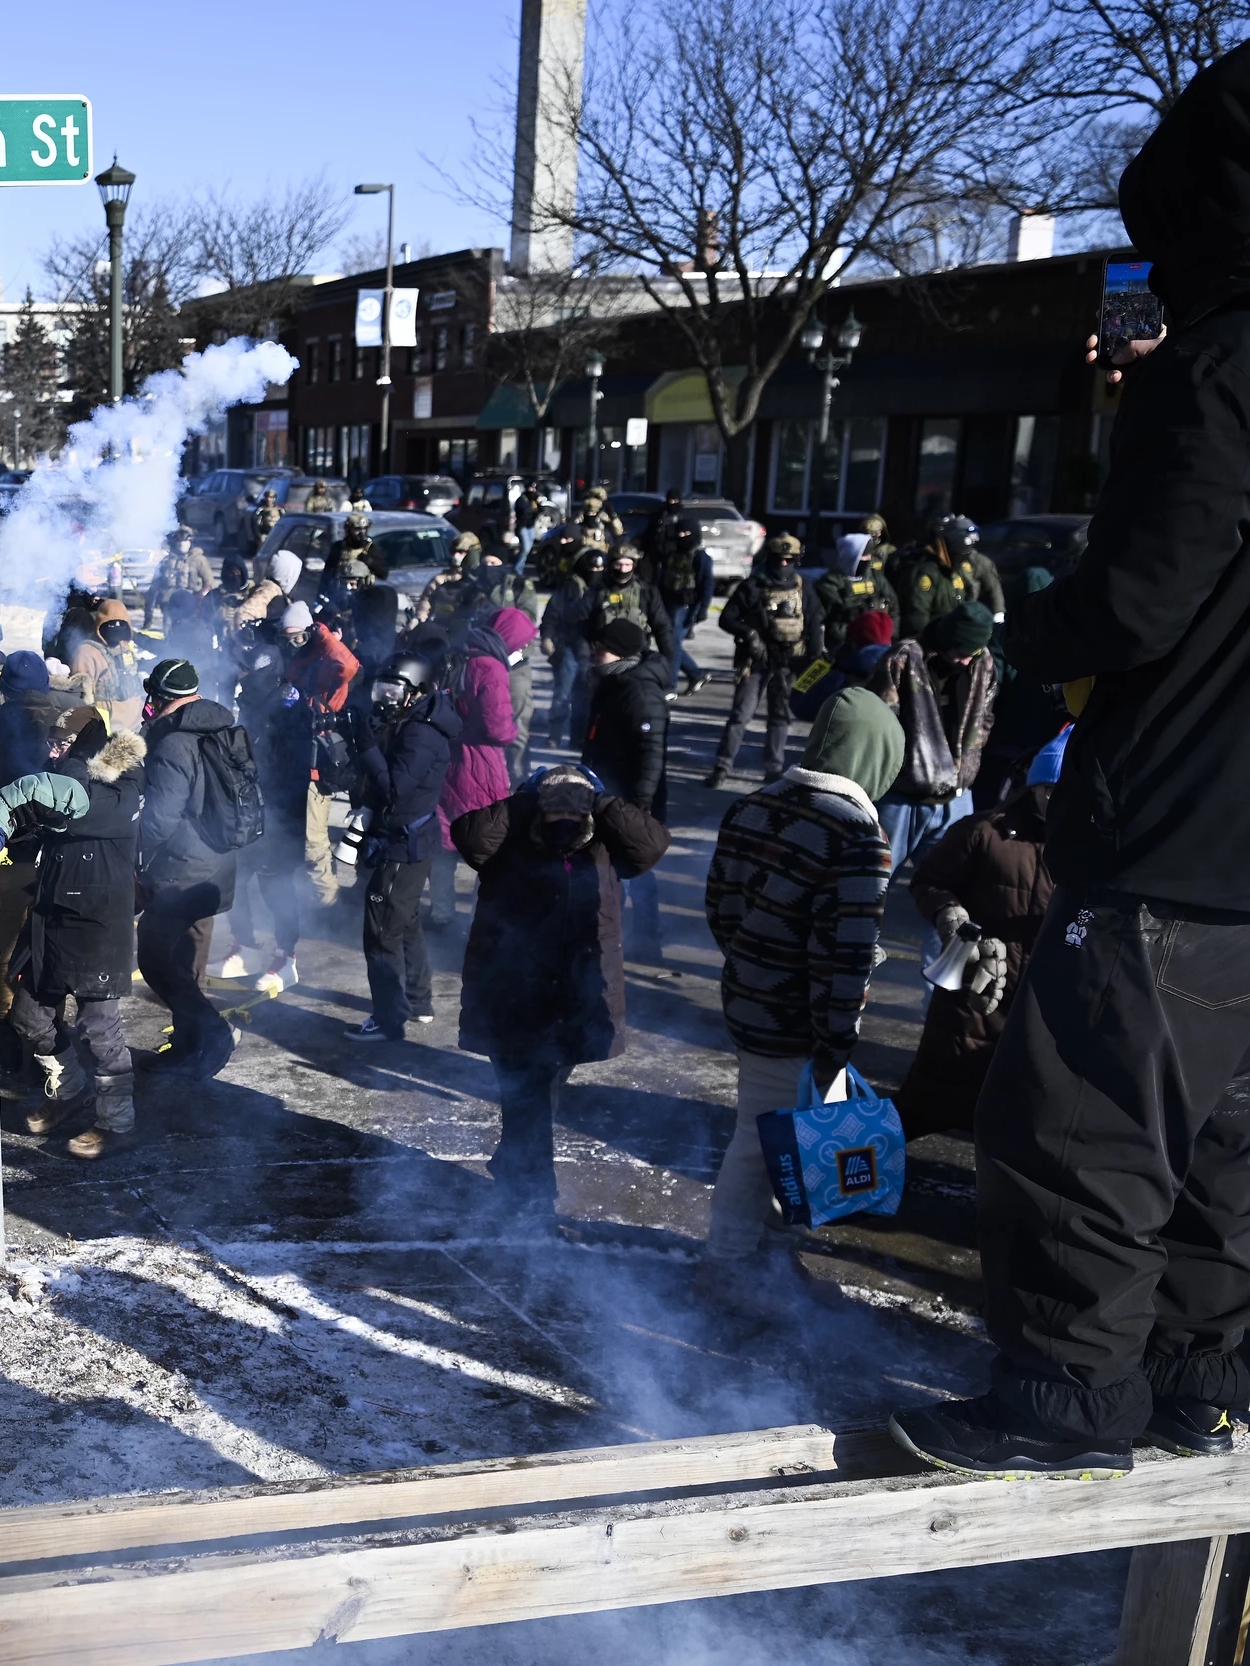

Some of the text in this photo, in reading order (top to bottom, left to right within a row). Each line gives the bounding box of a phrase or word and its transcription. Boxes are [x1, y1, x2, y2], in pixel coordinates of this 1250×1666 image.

[31, 113, 80, 167] St
[780, 1153, 802, 1206] aldi.us
[846, 1174, 871, 1186] ALDI
